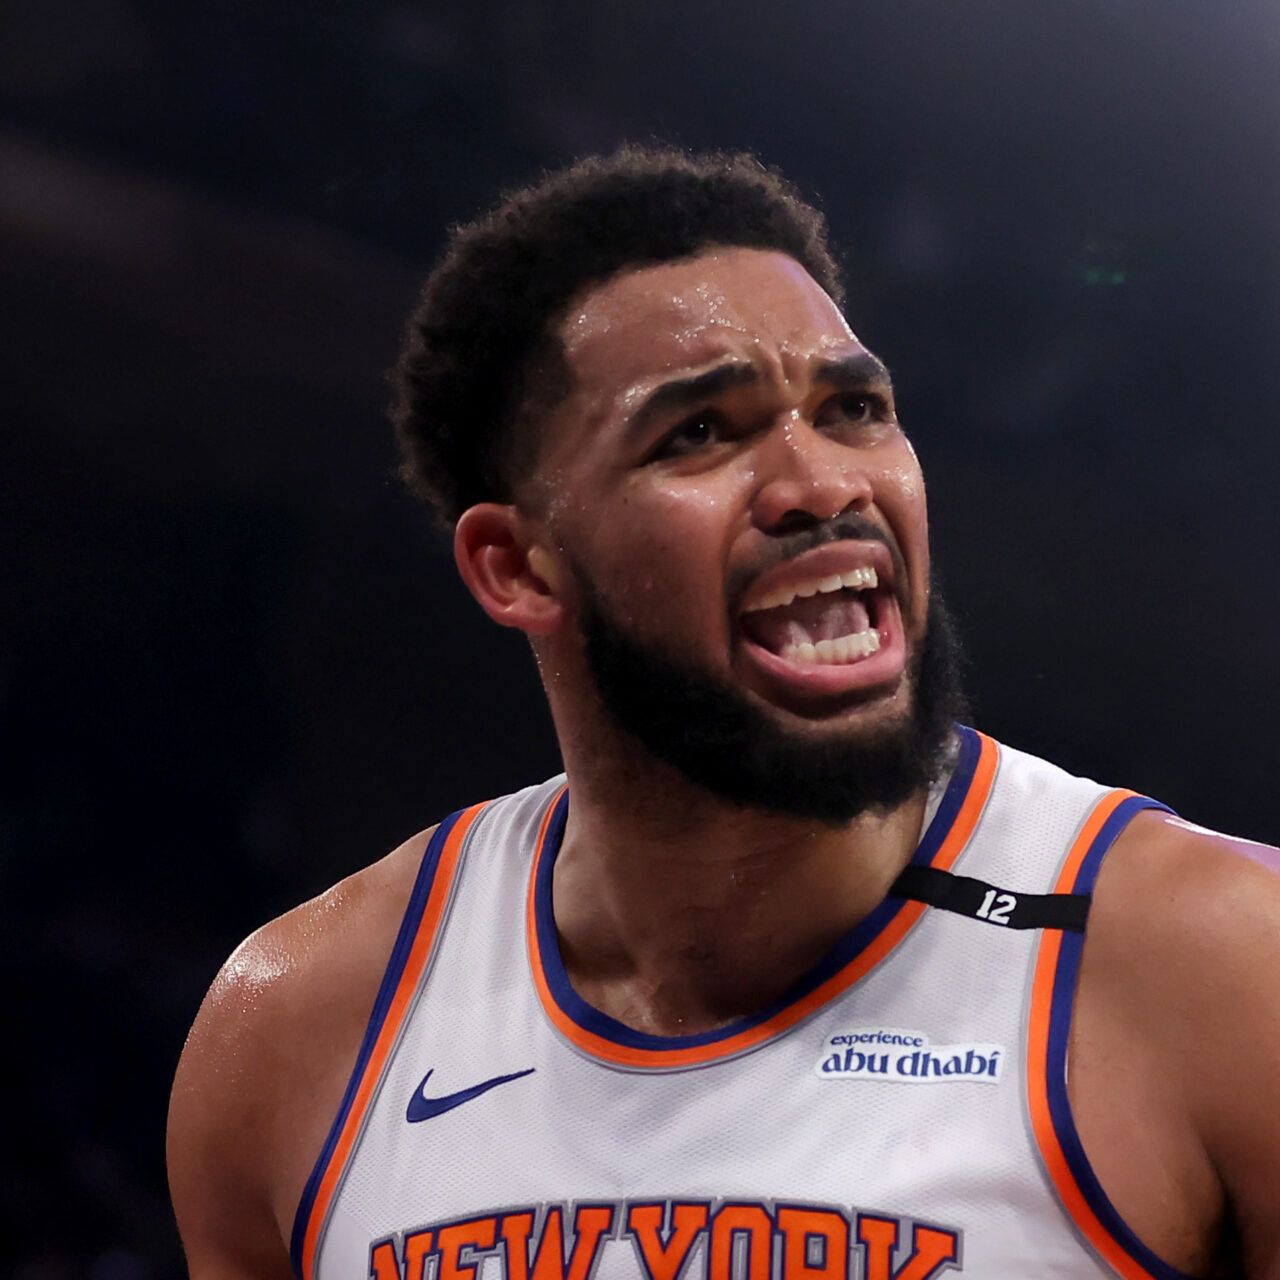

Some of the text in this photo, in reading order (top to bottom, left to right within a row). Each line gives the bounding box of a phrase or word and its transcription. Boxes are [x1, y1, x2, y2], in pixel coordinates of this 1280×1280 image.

[975, 889, 1018, 925] 12
[830, 1030, 923, 1048] experience
[821, 1047, 1000, 1078] abu dhabi
